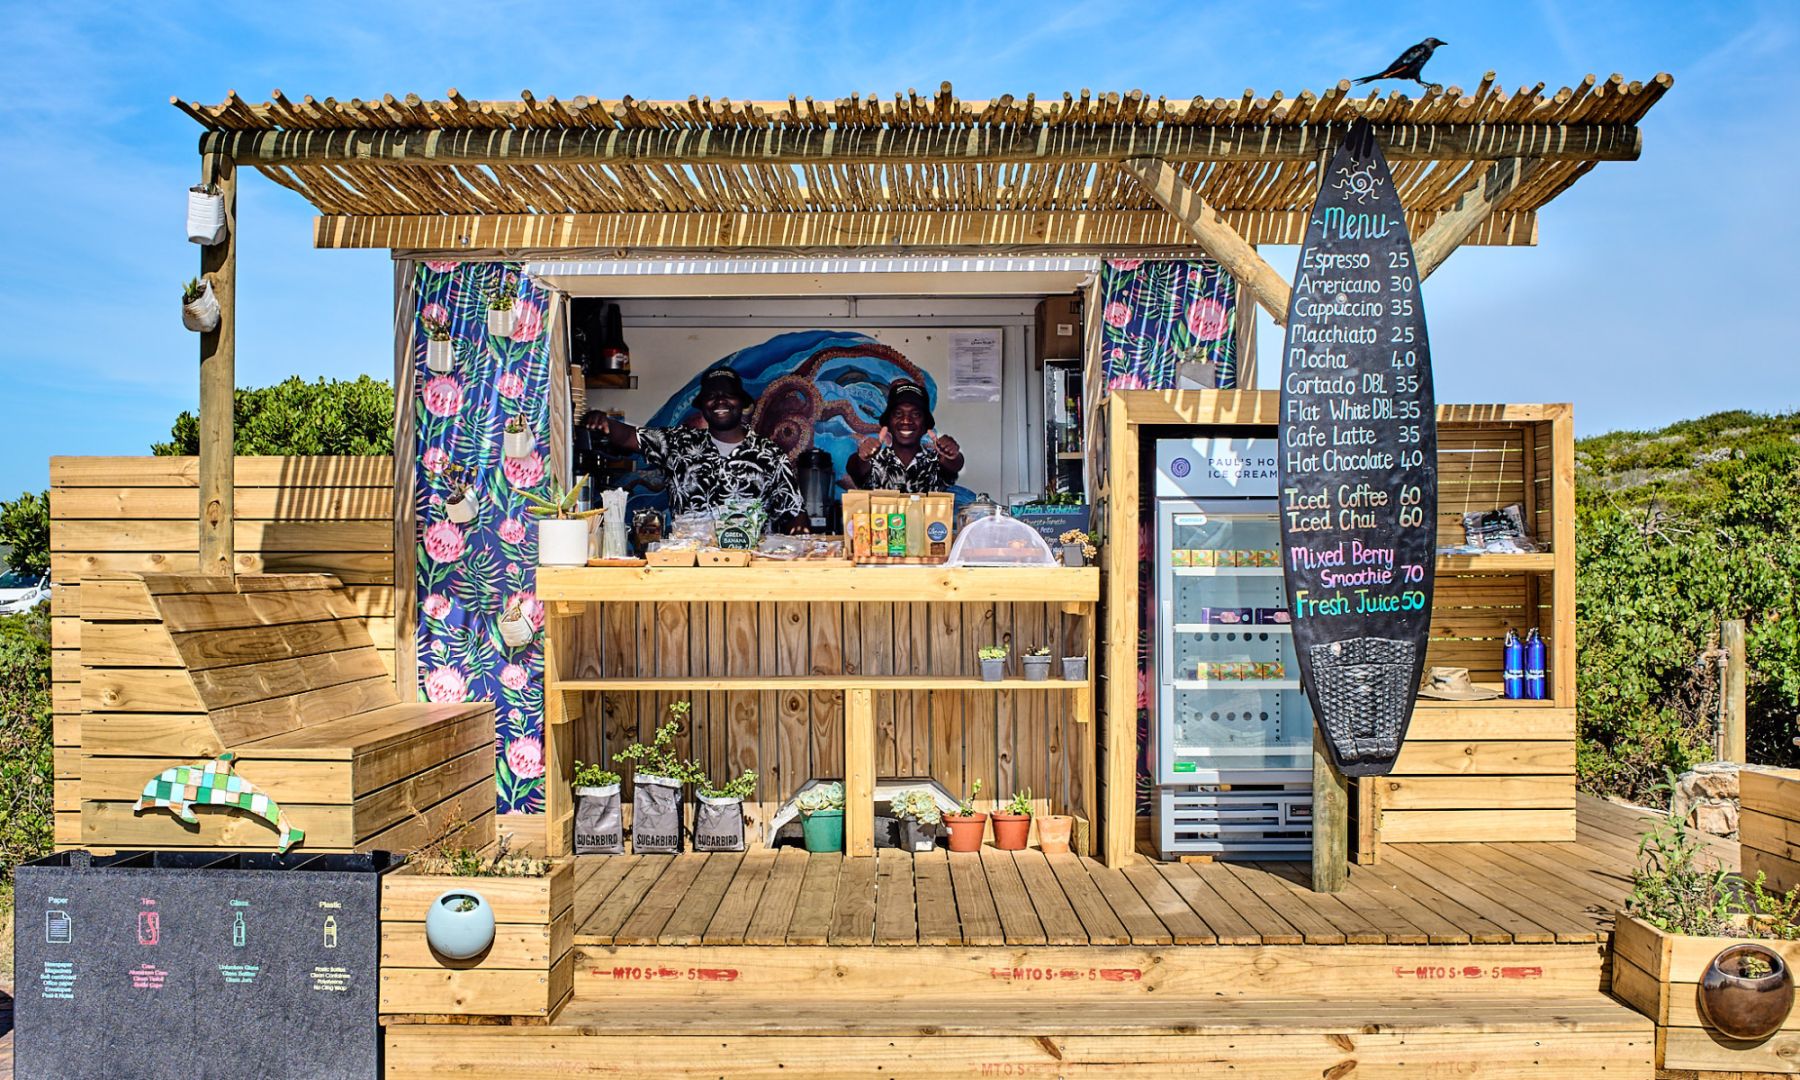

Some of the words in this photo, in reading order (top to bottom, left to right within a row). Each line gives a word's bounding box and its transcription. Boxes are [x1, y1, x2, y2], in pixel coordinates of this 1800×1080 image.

[1303, 247, 1370, 276] Espresso
[1388, 252, 1410, 268] 25
[1296, 273, 1381, 294] Americano
[1390, 276, 1413, 293] 30
[1295, 297, 1383, 324] Cappuccino
[1390, 300, 1413, 316] 35
[1291, 324, 1377, 344] Macchiato
[1391, 327, 1415, 343] 25
[1289, 348, 1349, 369] Mocha
[1391, 350, 1416, 370] 40
[1286, 372, 1355, 394] Cortado
[1362, 373, 1387, 394] DBL
[1396, 375, 1418, 393] 35
[1287, 400, 1320, 422] Flat
[1330, 399, 1370, 421] White
[1372, 398, 1398, 420] DBL
[1399, 401, 1420, 420] 35
[1286, 425, 1327, 447] Cafe
[1333, 425, 1377, 446] Latte
[1398, 425, 1420, 443] 35
[1208, 458, 1252, 466] PAUL'S
[1258, 458, 1279, 466] HO
[1287, 452, 1320, 472] Hot
[1323, 449, 1394, 472] Chocolate
[1401, 450, 1423, 471] 40
[1208, 470, 1229, 478] ICE
[1235, 470, 1278, 478] CREAM
[1284, 487, 1331, 511] Iced
[1338, 483, 1388, 508] Coffee
[1400, 485, 1421, 505] 60
[1287, 510, 1333, 533] Iced
[1338, 510, 1377, 531] Chai
[1399, 506, 1423, 528] 60
[1291, 541, 1345, 572] Mixed
[1352, 540, 1394, 570] Berry
[1320, 569, 1393, 589] Smoothie
[1401, 565, 1424, 583] 70
[1295, 590, 1350, 618] Fresh
[1354, 589, 1400, 616] Juice
[1401, 590, 1425, 610] 50
[577, 833, 618, 846] SUGARBIRD
[637, 833, 677, 847] SUGARBIRD
[697, 834, 738, 847] SUGARBIRD
[1088, 968, 1096, 981] 5
[1491, 967, 1500, 979] 5
